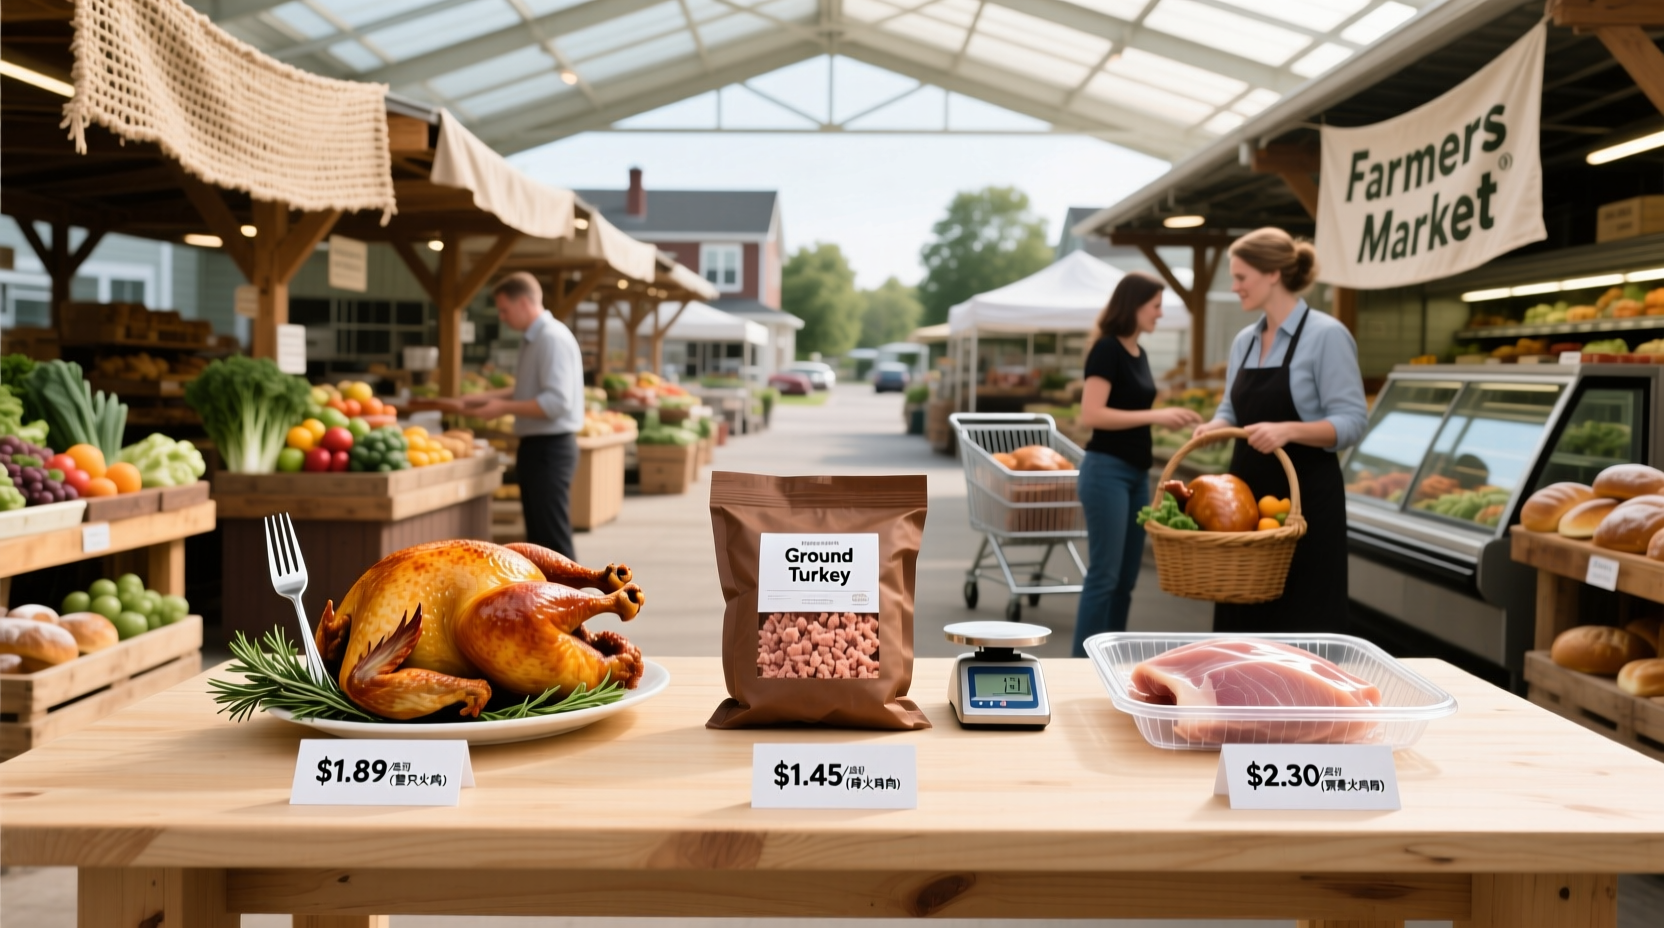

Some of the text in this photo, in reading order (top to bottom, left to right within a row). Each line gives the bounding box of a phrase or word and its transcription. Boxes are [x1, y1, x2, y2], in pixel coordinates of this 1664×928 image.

[1345, 104, 1507, 203] Farmers
[1357, 171, 1497, 263] Market
[785, 547, 853, 563] Ground
[788, 567, 851, 586] Turkey
